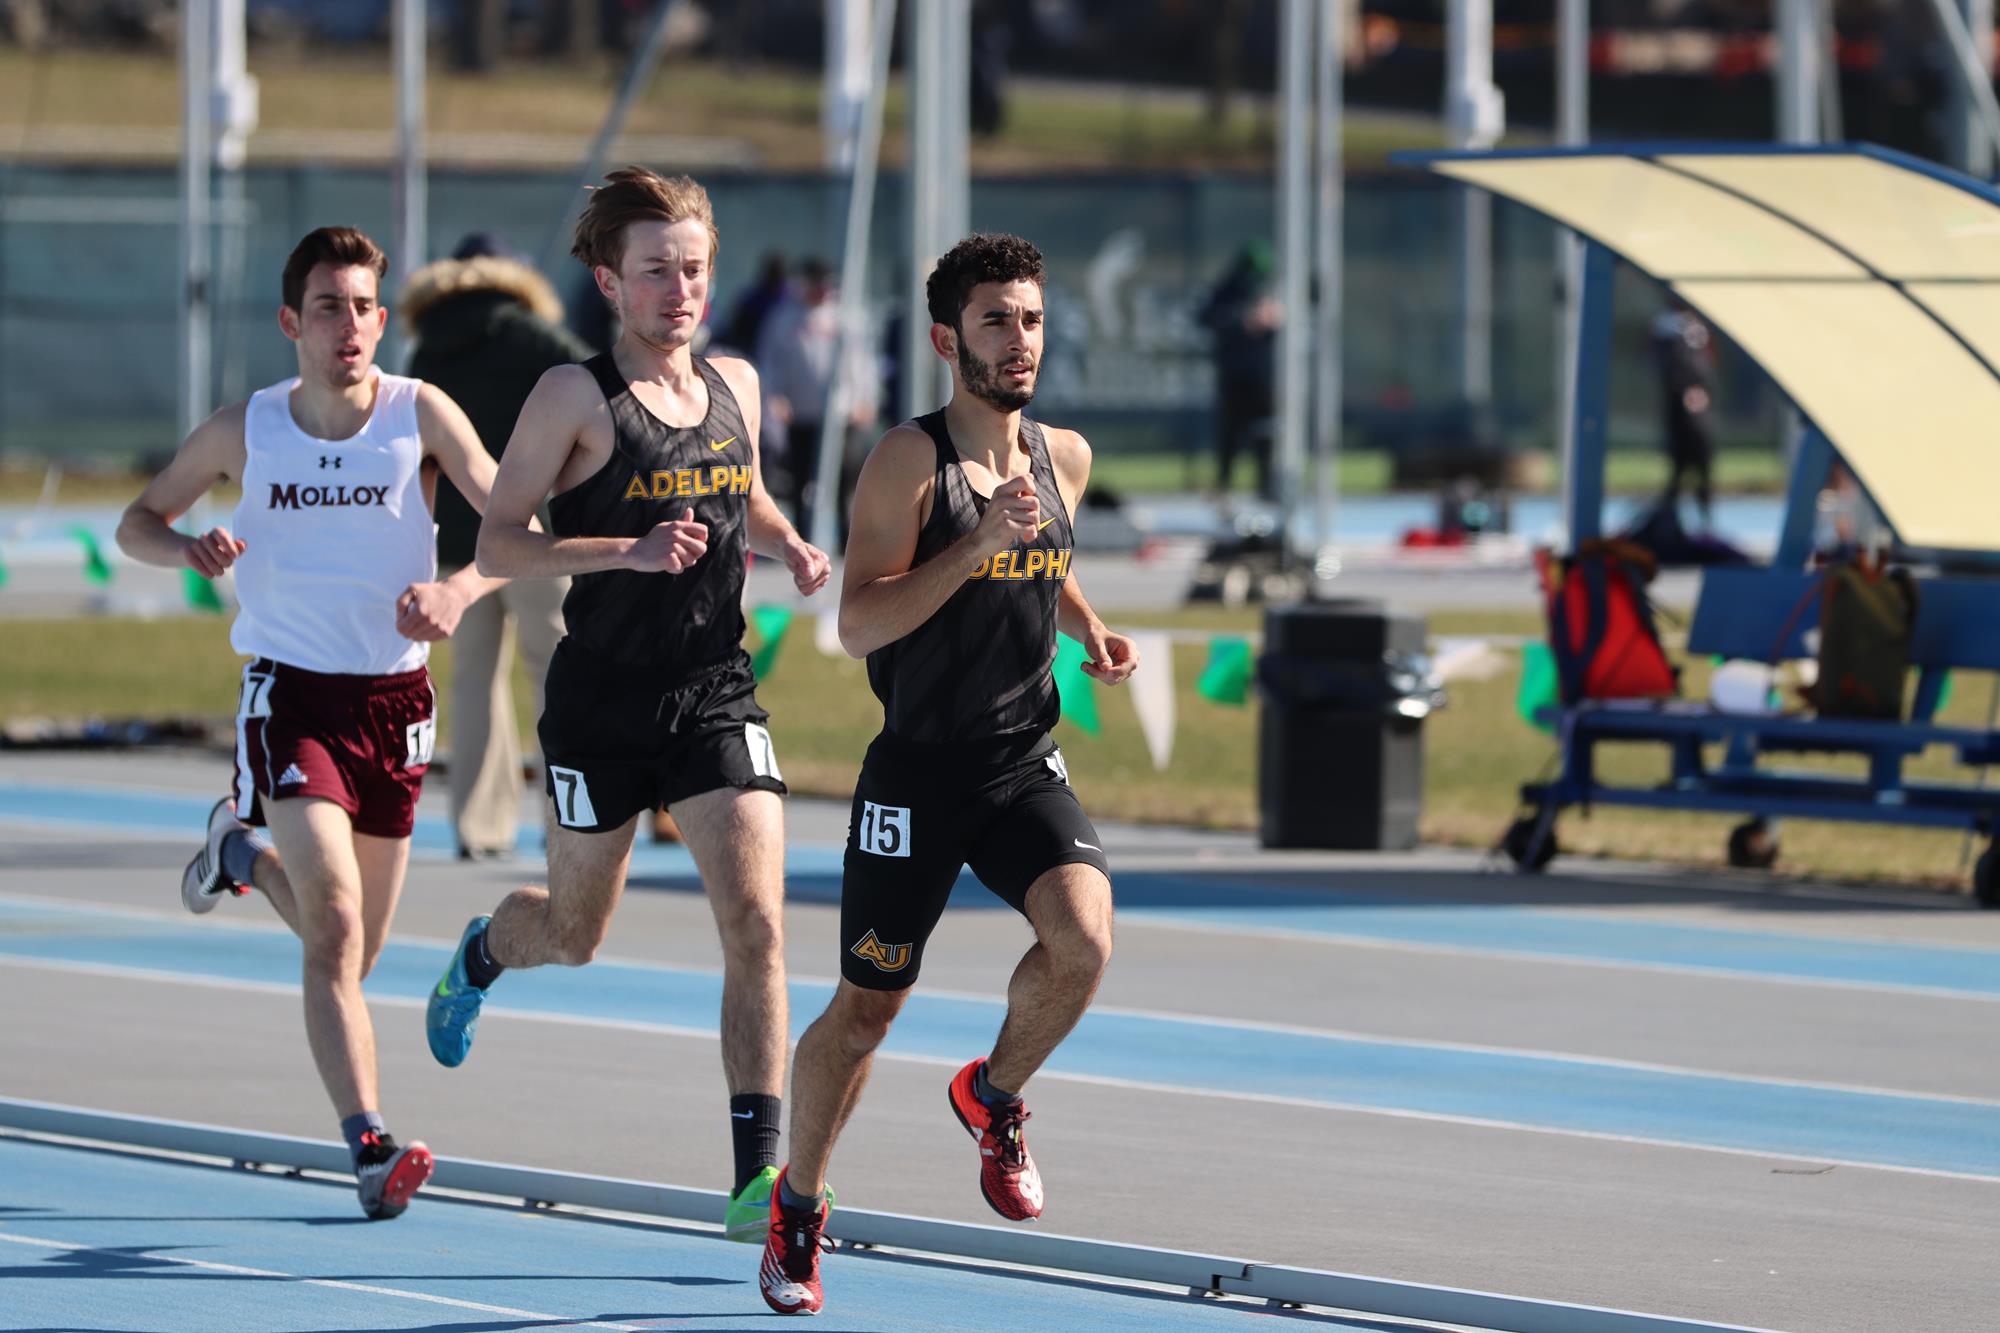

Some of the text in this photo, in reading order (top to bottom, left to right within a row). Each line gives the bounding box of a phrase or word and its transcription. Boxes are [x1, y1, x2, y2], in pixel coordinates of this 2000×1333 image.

[268, 483, 390, 511] MOLLOY
[555, 771, 577, 822] 7
[866, 805, 901, 854] 15
[851, 928, 913, 972] AU
